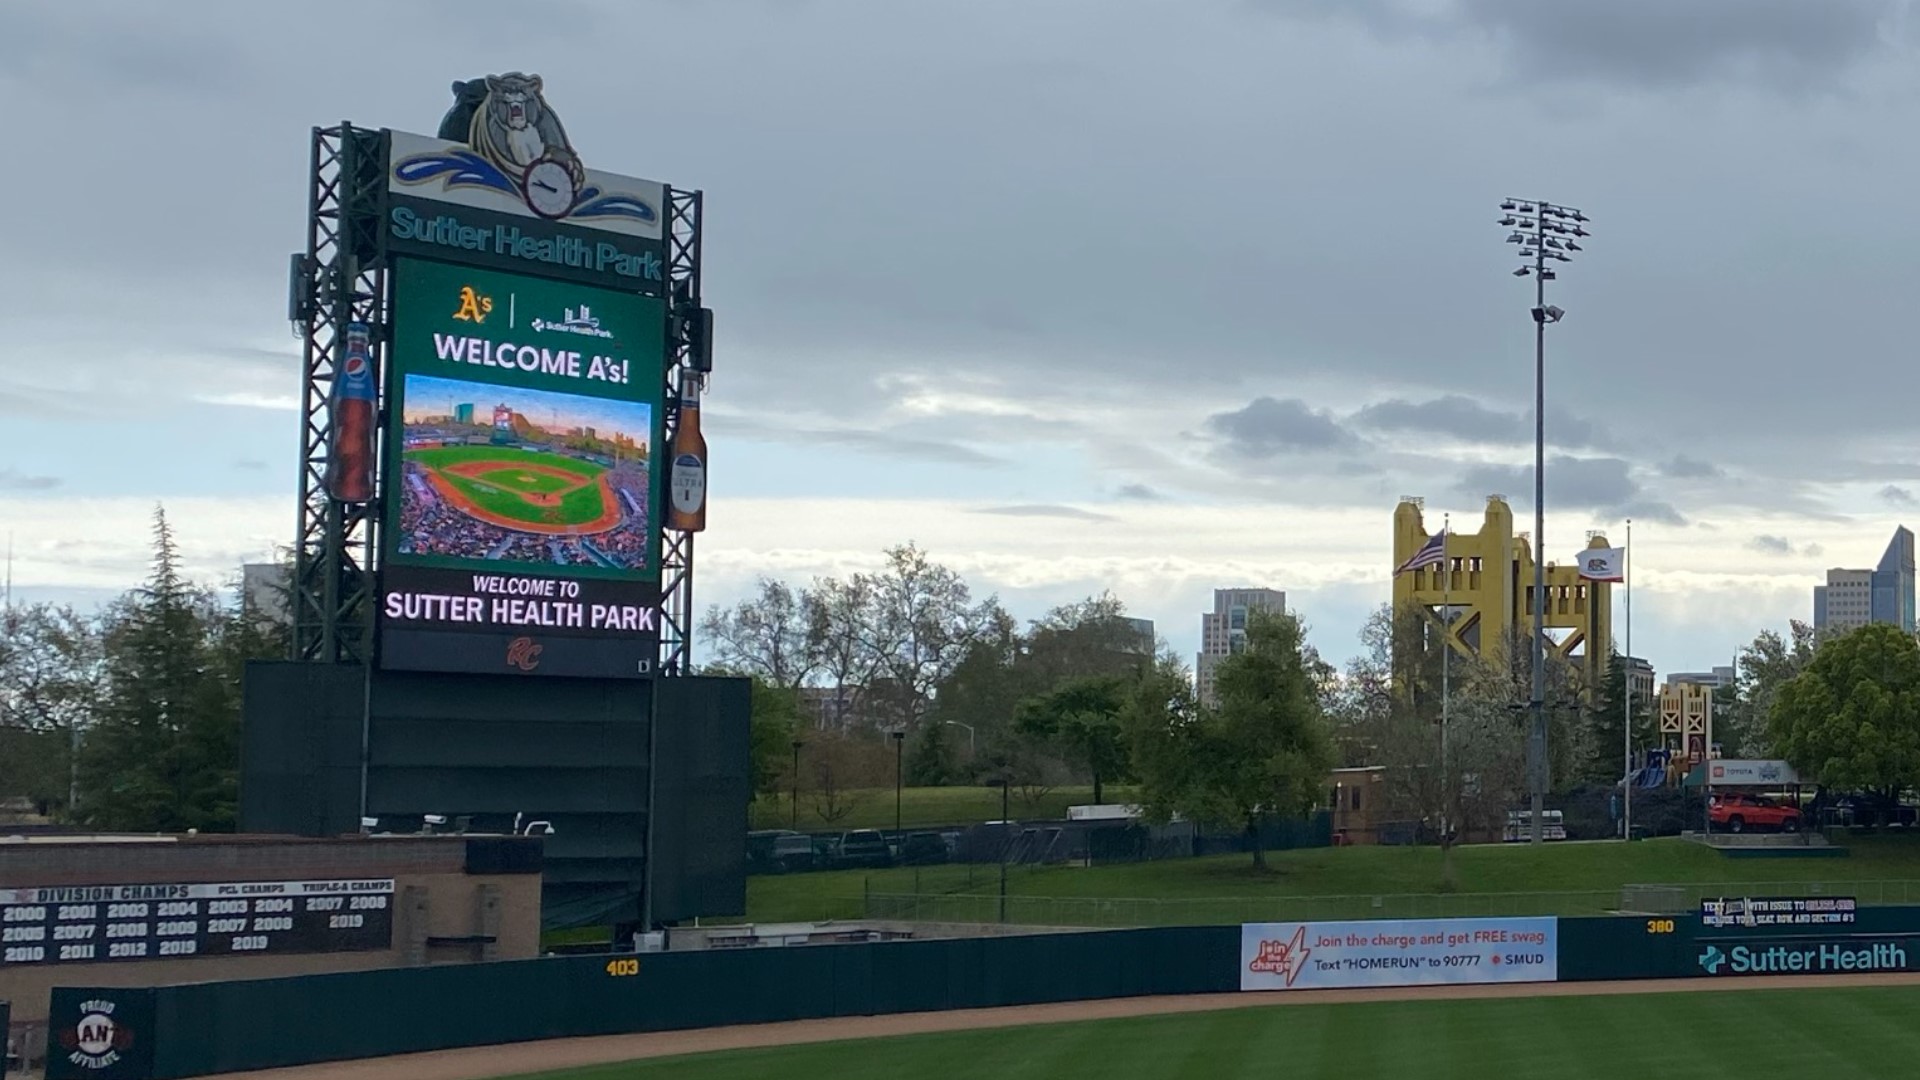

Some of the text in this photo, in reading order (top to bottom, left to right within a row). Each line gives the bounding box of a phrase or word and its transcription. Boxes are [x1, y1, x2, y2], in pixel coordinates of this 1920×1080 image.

[391, 206, 662, 281] Sutter Health Park
[452, 286, 492, 324] A's
[546, 321, 570, 332] Sutter
[569, 324, 594, 336] Health
[433, 332, 629, 385] WELCOME A's!
[473, 575, 580, 598] WELCOME TO
[384, 592, 654, 632] SUTTER HEALTH PARK
[1726, 768, 1753, 776] TOYOTA
[37, 885, 189, 902] DIVISION CHAMPS
[218, 884, 285, 895] PCL CHAMPS
[302, 881, 392, 892] TRIPLE-A CHAMPS
[208, 899, 294, 914] 2003 2004
[306, 896, 387, 911] 2007 2008
[1769, 901, 1793, 911] ISSUE
[1794, 901, 1805, 911] TO
[3, 902, 198, 922] 2000 2001 2003 2004
[1795, 913, 1811, 923] AND
[1811, 912, 1842, 923] SECTION
[207, 917, 293, 933] 2007 2008
[329, 914, 364, 928] 2019
[1647, 919, 1675, 933] 380
[2, 926, 46, 942] 2005
[53, 924, 96, 940] 2007
[1315, 930, 1548, 949] Join the charge and get FREE swag.
[231, 936, 268, 951] 2019
[4, 946, 45, 962] 2010
[59, 944, 95, 960] 2011
[109, 942, 147, 957] 2012
[1505, 953, 1544, 965] SMUD
[1730, 943, 1906, 972] Sutter Health
[606, 959, 639, 976] 403
[1314, 955, 1481, 971] Text "HOMERUN" to 90777
[79, 1000, 116, 1015] PROUD
[68, 1050, 121, 1069] AFFILIATE
